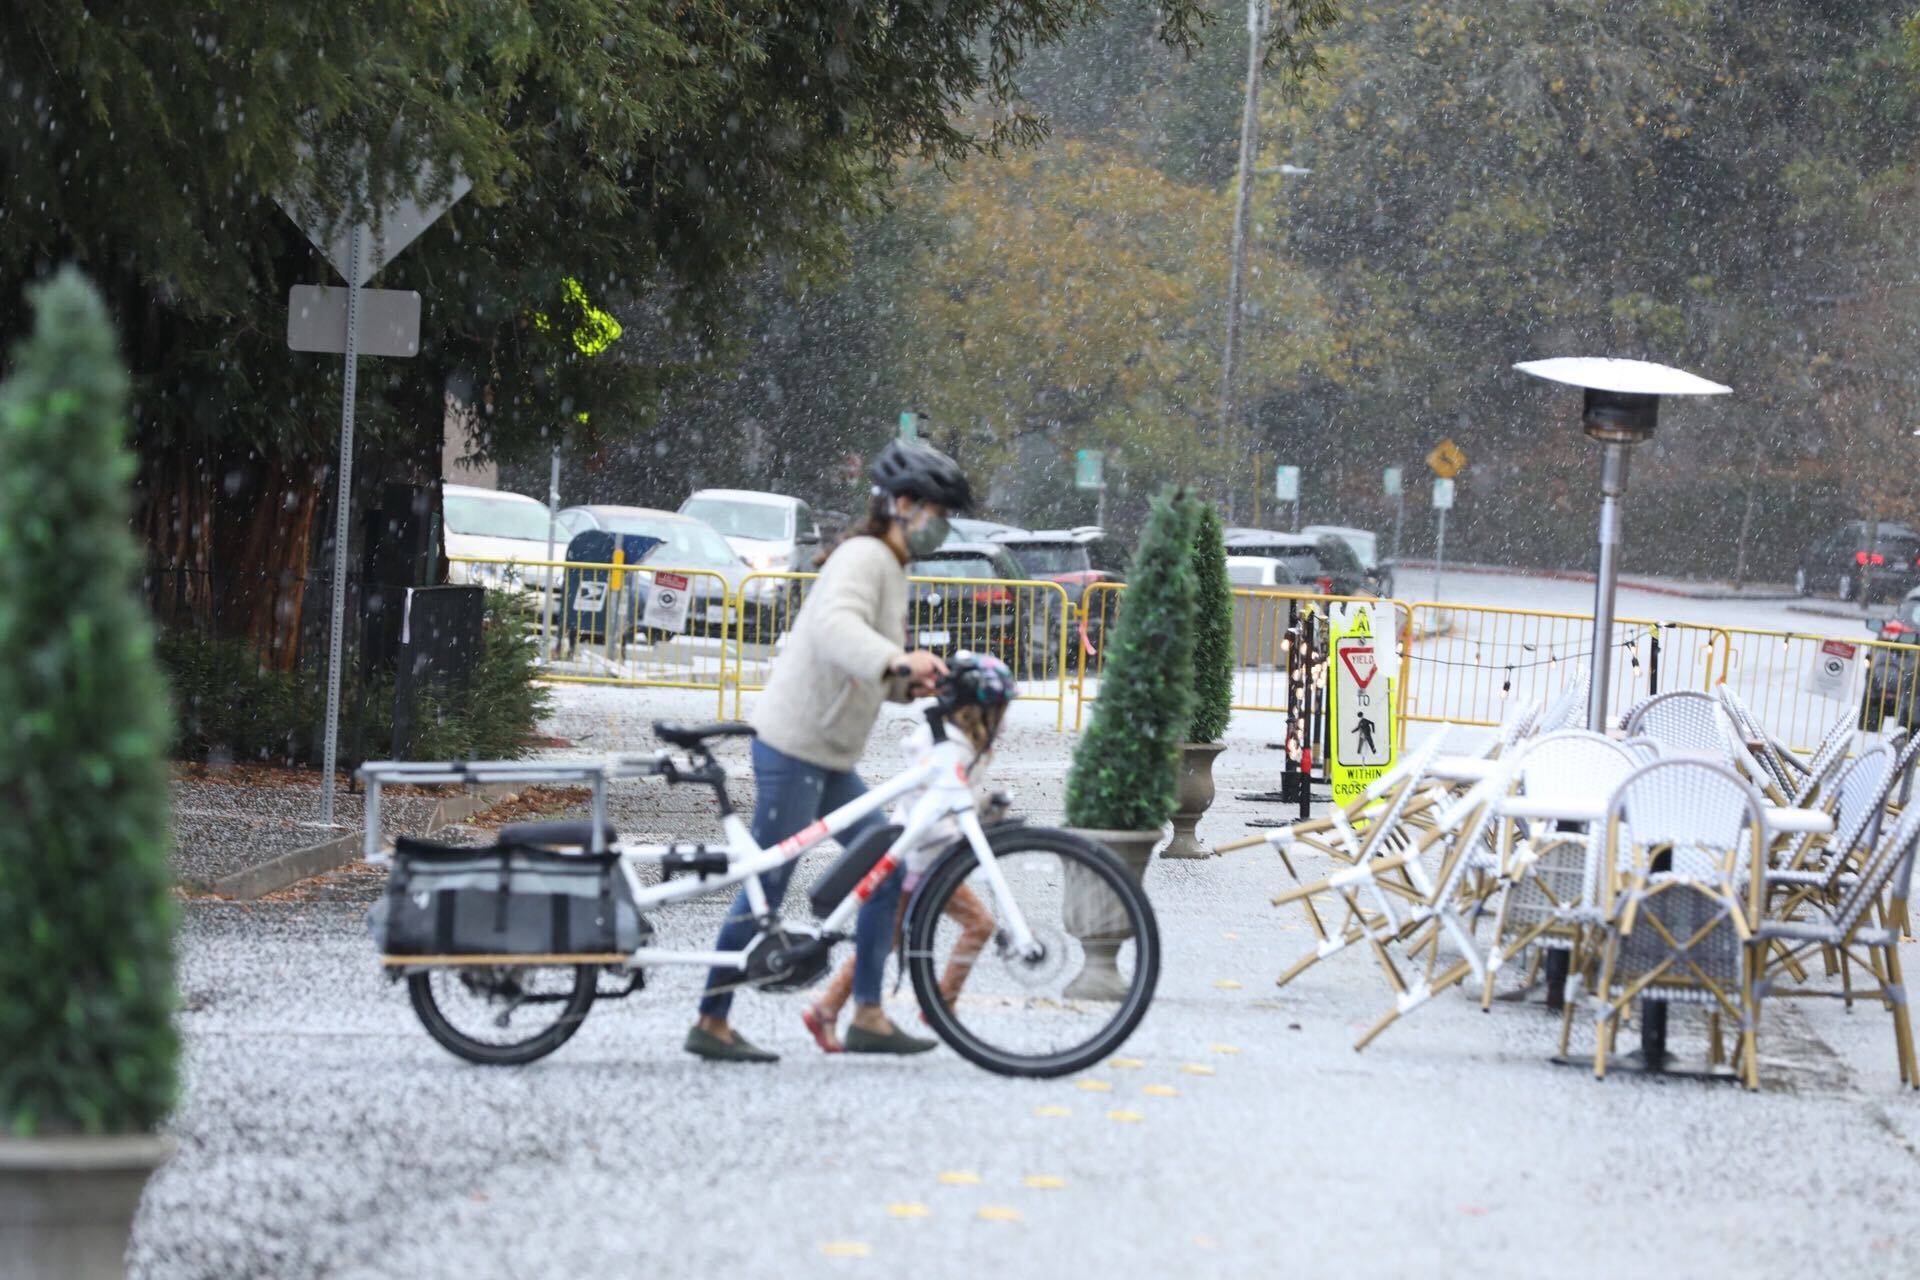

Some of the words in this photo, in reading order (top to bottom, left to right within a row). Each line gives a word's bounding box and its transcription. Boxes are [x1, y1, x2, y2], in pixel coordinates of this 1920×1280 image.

[1352, 655, 1374, 665] YIELD
[1357, 694, 1371, 707] TO
[1347, 769, 1382, 780] WITHIN
